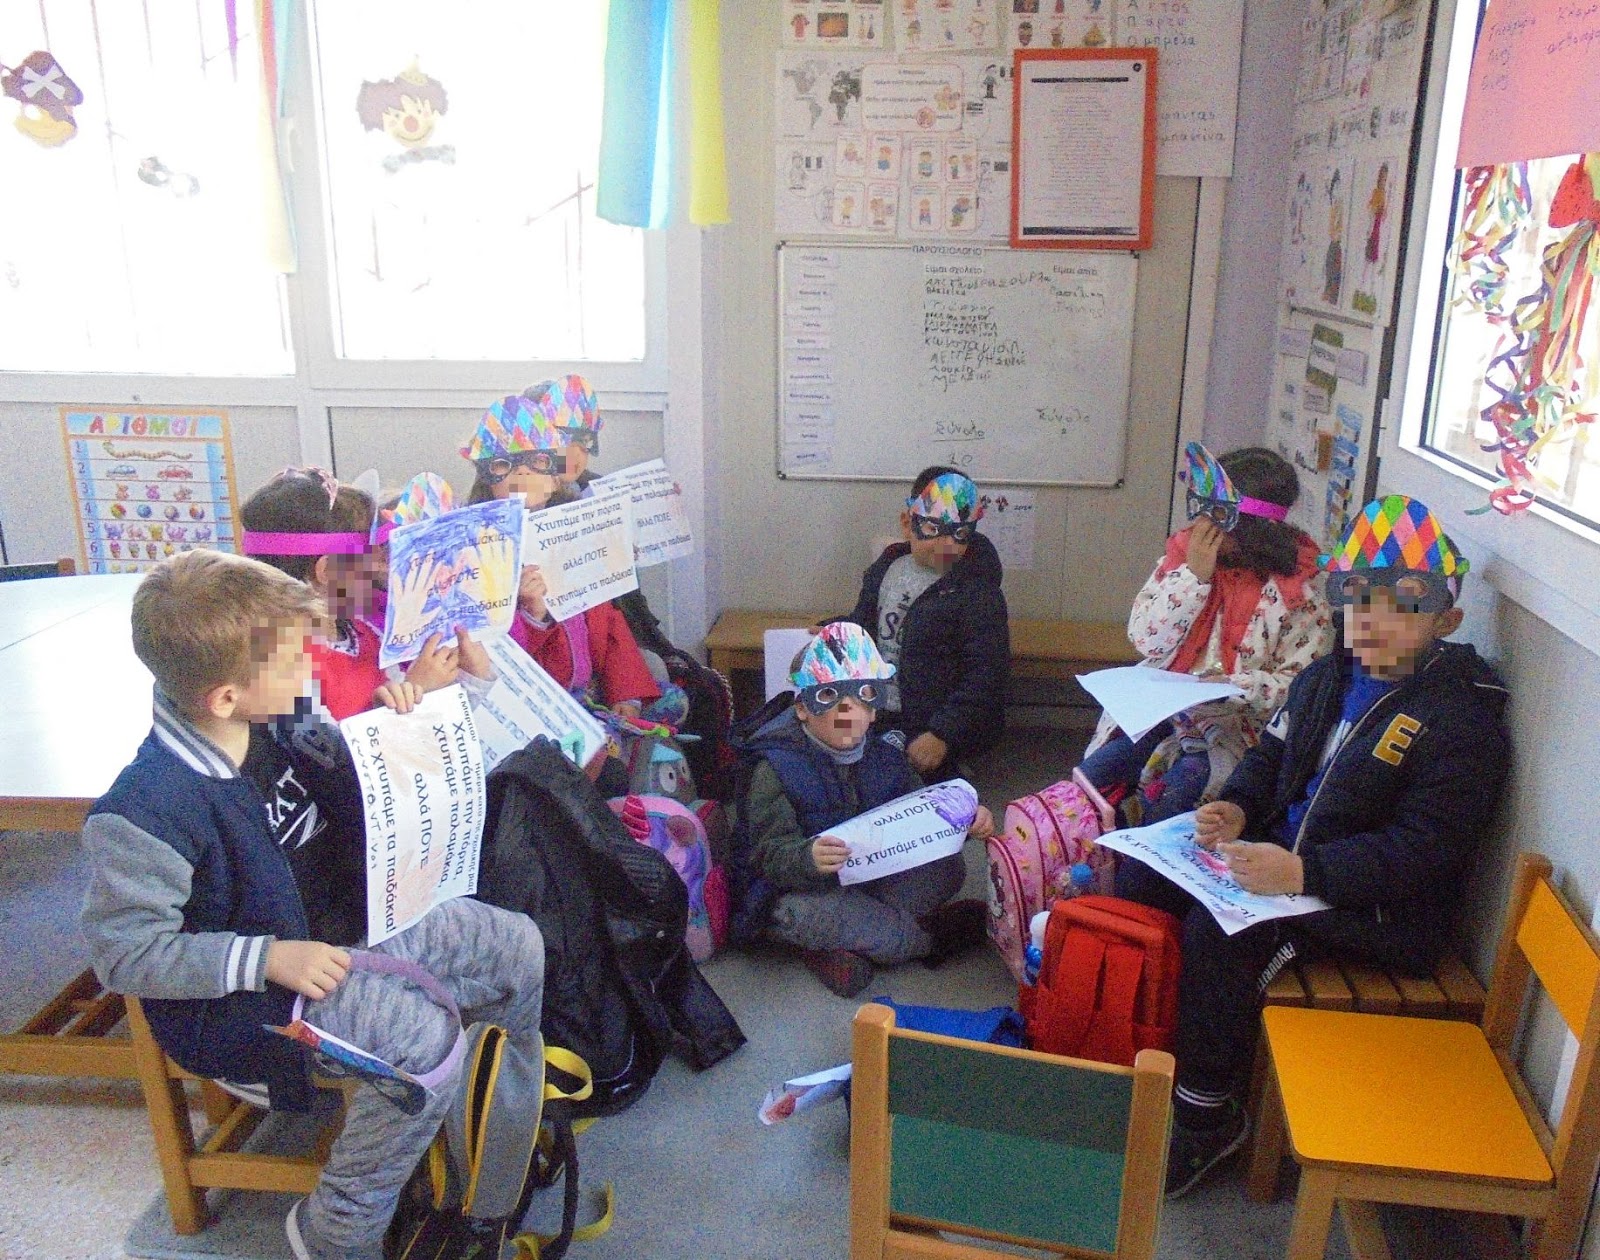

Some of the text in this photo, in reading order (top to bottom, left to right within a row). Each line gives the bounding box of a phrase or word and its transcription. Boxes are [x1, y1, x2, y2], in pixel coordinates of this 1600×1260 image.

[76, 441, 83, 453] 1
[78, 463, 85, 474] 2
[81, 482, 89, 494] 3
[84, 502, 92, 514] 4
[581, 510, 595, 521] την
[87, 522, 96, 534] 5
[90, 542, 98, 553] 6
[584, 546, 608, 564] ΠΟΤΕ
[94, 561, 101, 572] 7
[589, 582, 598, 591] τα
[391, 633, 405, 646] δε
[1372, 713, 1421, 766] E
[433, 723, 459, 797] χτυπάμε
[452, 721, 473, 795] Χτυπάμε
[463, 799, 474, 825] την
[874, 799, 940, 827] αλλά ΠΟΤΕ
[414, 772, 433, 870] αλλά ΠΟΤΕ
[366, 725, 397, 934] δε χτυπάμε τα παιδάκια!
[865, 841, 918, 866] χτυπάμε
[920, 834, 934, 845] τα
